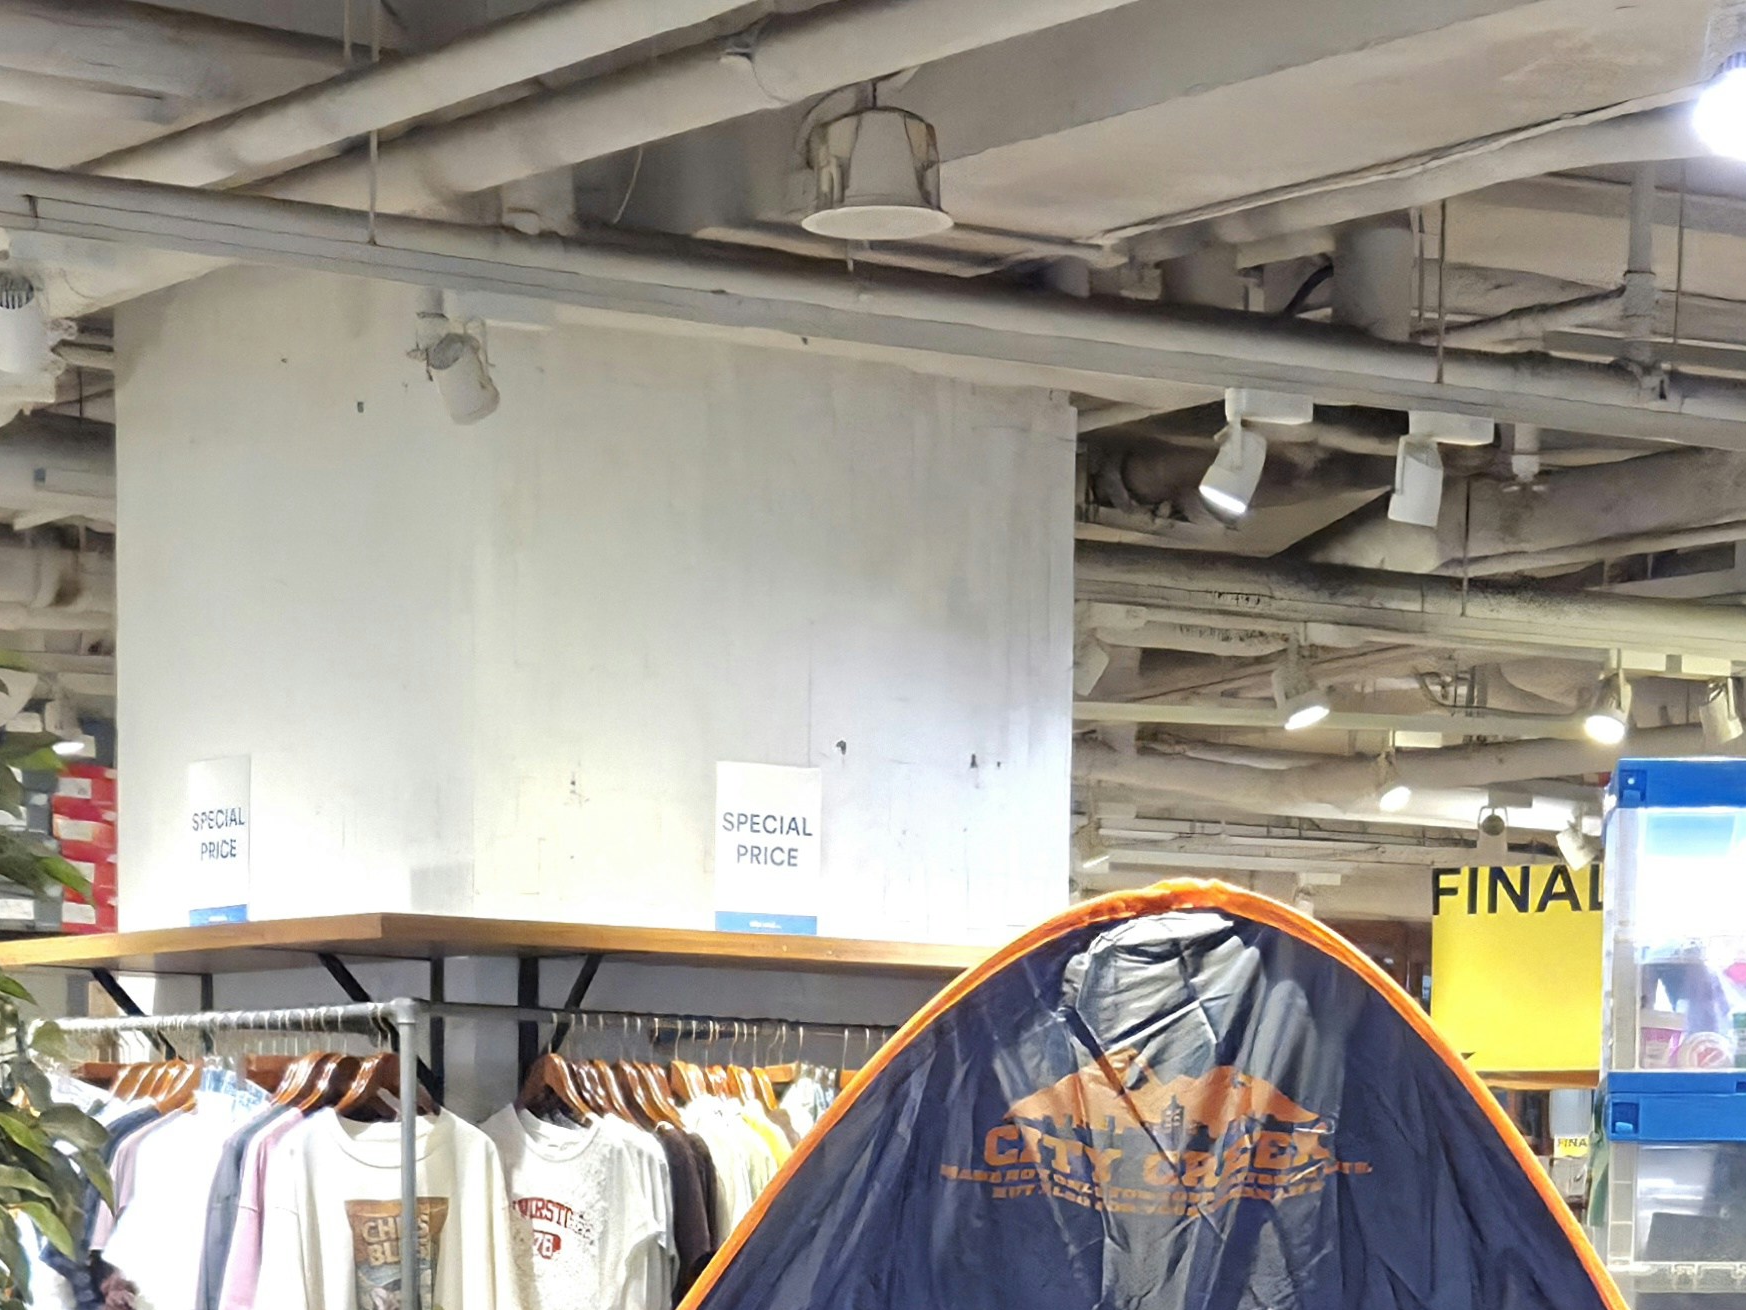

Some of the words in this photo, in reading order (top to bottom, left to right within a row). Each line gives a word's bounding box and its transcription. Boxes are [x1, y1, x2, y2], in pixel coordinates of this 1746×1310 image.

[192, 807, 245, 831] SPECIAL
[722, 812, 813, 837] SPECIAL
[200, 838, 237, 861] PRICE
[736, 844, 799, 867] PRICE
[1432, 864, 1603, 916] FINAL
[984, 1124, 1123, 1184] CITY
[1557, 1137, 1589, 1148] FINA
